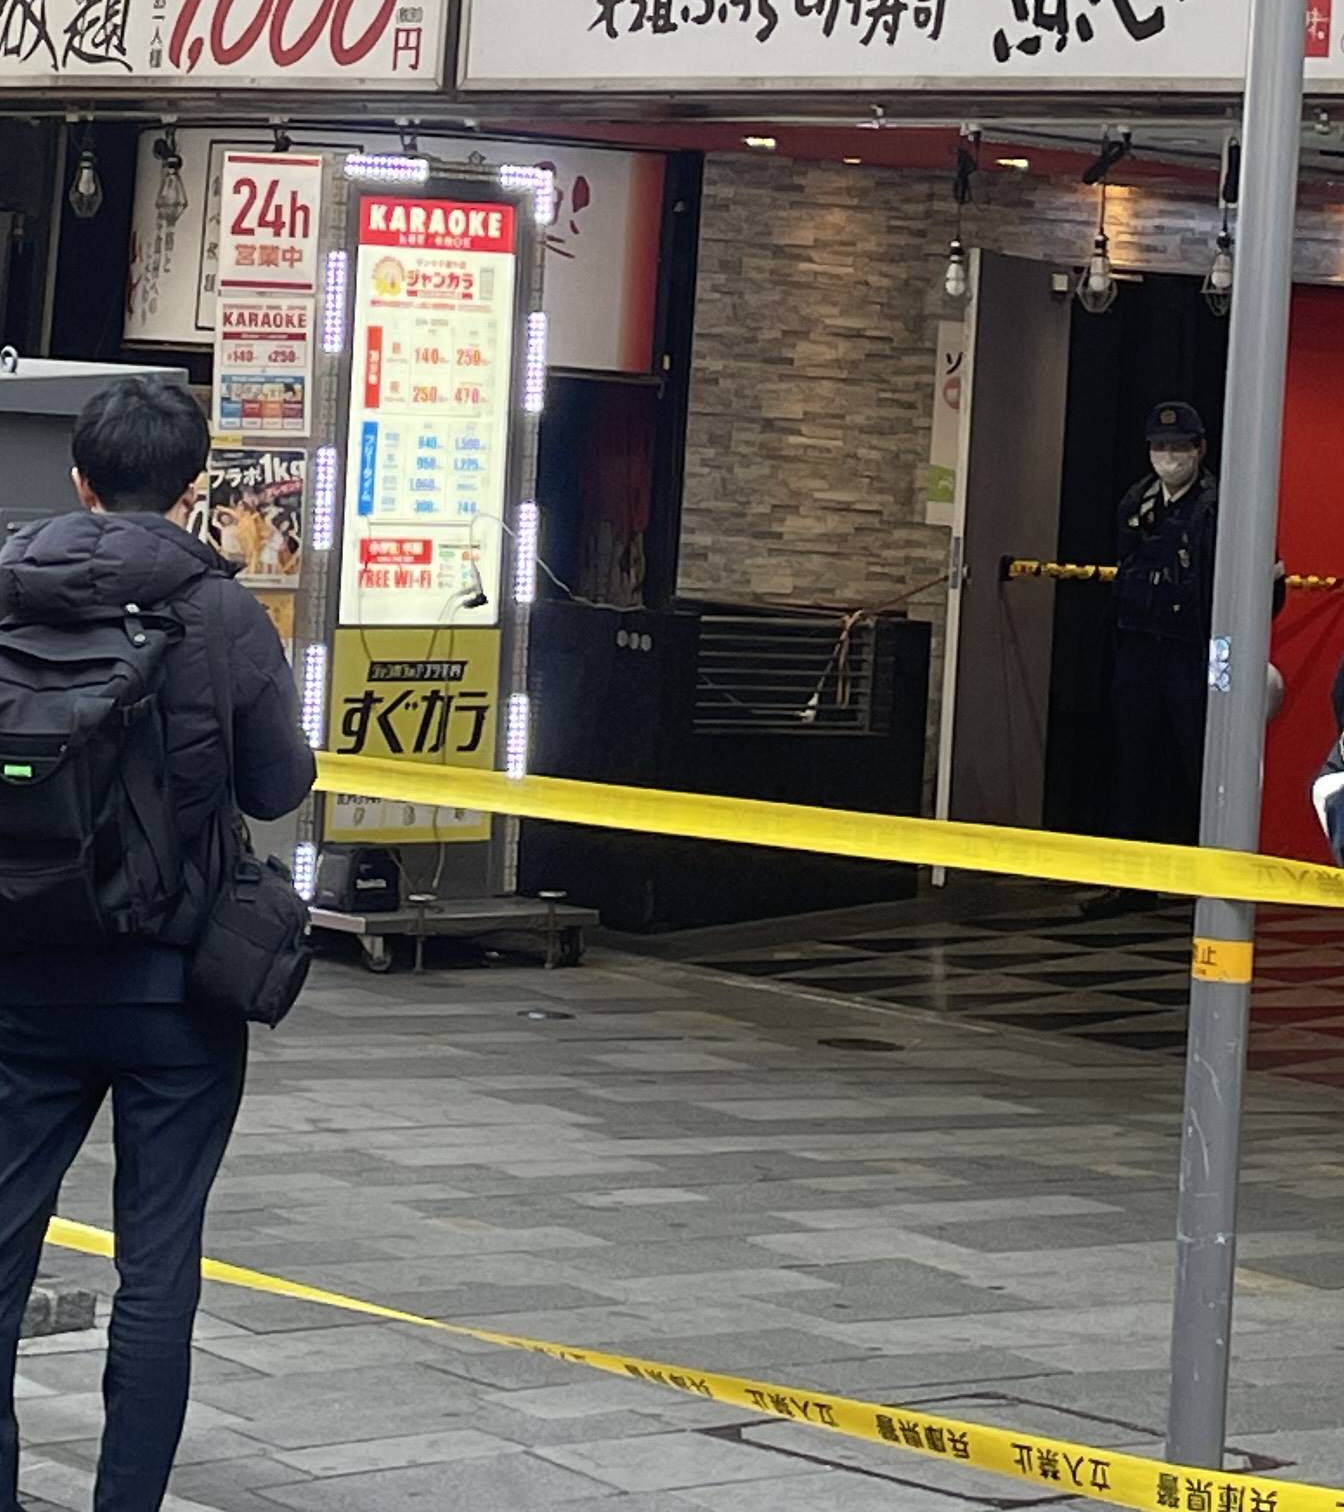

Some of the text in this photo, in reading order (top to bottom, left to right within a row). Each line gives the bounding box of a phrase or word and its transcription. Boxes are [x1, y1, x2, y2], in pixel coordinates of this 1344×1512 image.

[230, 178, 310, 238] 24h
[369, 204, 502, 238] KARAOKE
[234, 243, 304, 268] 営業中
[407, 269, 474, 289] ジャンカラ
[223, 311, 306, 329] KARAOKE
[358, 569, 391, 589] FREE
[337, 689, 490, 755] すぐカラ
